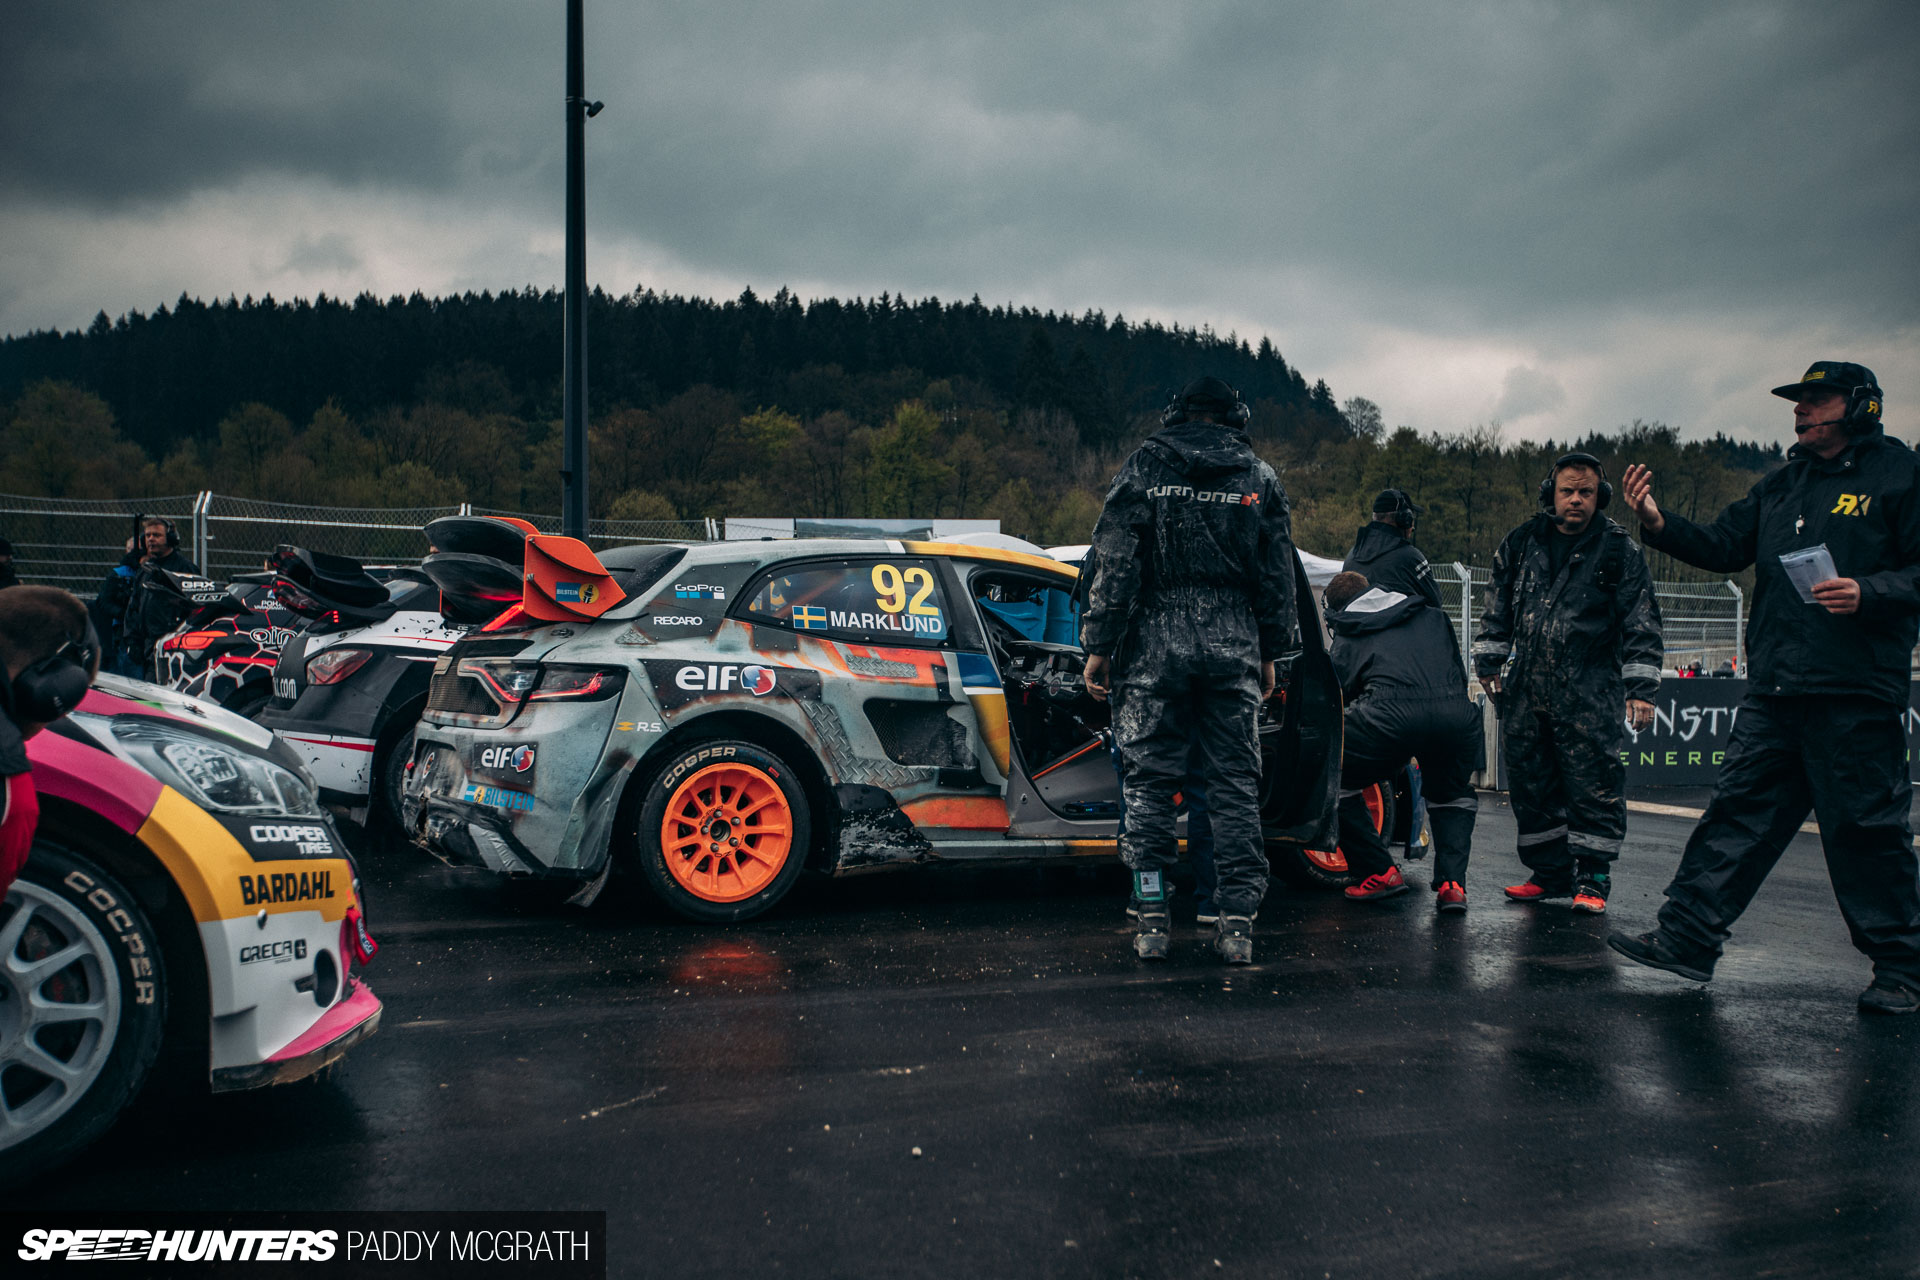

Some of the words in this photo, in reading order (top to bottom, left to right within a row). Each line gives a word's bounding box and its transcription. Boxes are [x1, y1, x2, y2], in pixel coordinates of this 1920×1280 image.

[556, 588, 579, 596] BILSTEIN
[674, 583, 725, 592] GoPro
[871, 563, 939, 616] 92
[653, 616, 703, 626] RECARO
[830, 610, 942, 633] MARKLUND
[675, 665, 738, 691] elf
[636, 721, 662, 733] R.S.
[481, 747, 512, 768] elf
[663, 747, 736, 789] COOPER
[1619, 751, 1726, 766] ENERG
[484, 786, 536, 812] BILSTEIN
[250, 825, 329, 843] COOPER
[296, 842, 333, 854] TIRES
[239, 871, 335, 906] BARDAHL
[64, 871, 155, 1005] COOPER
